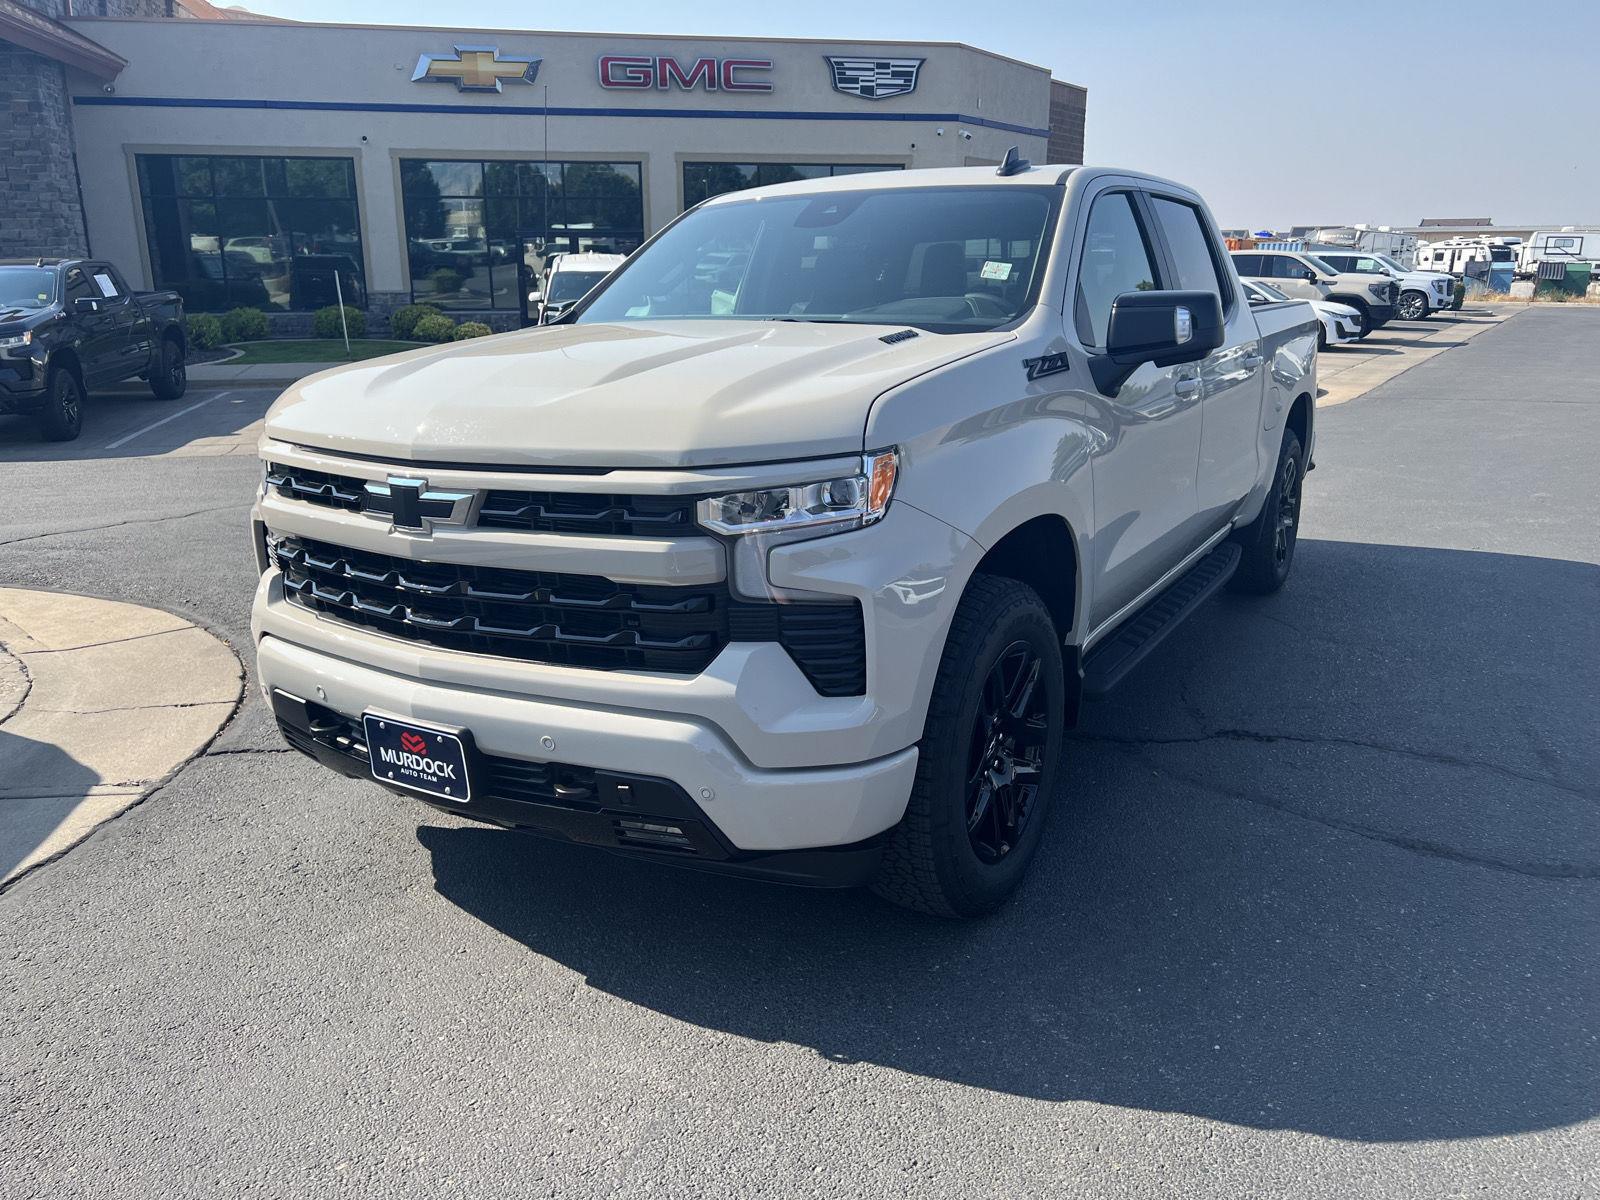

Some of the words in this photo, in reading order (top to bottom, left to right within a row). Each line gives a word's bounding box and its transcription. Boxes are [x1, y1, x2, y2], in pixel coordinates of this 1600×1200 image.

[598, 55, 774, 92] GMC
[1022, 352, 1070, 382] Z71
[380, 746, 456, 780] MURDOCK
[401, 767, 418, 777] AUTO
[420, 772, 438, 782] TEAM
